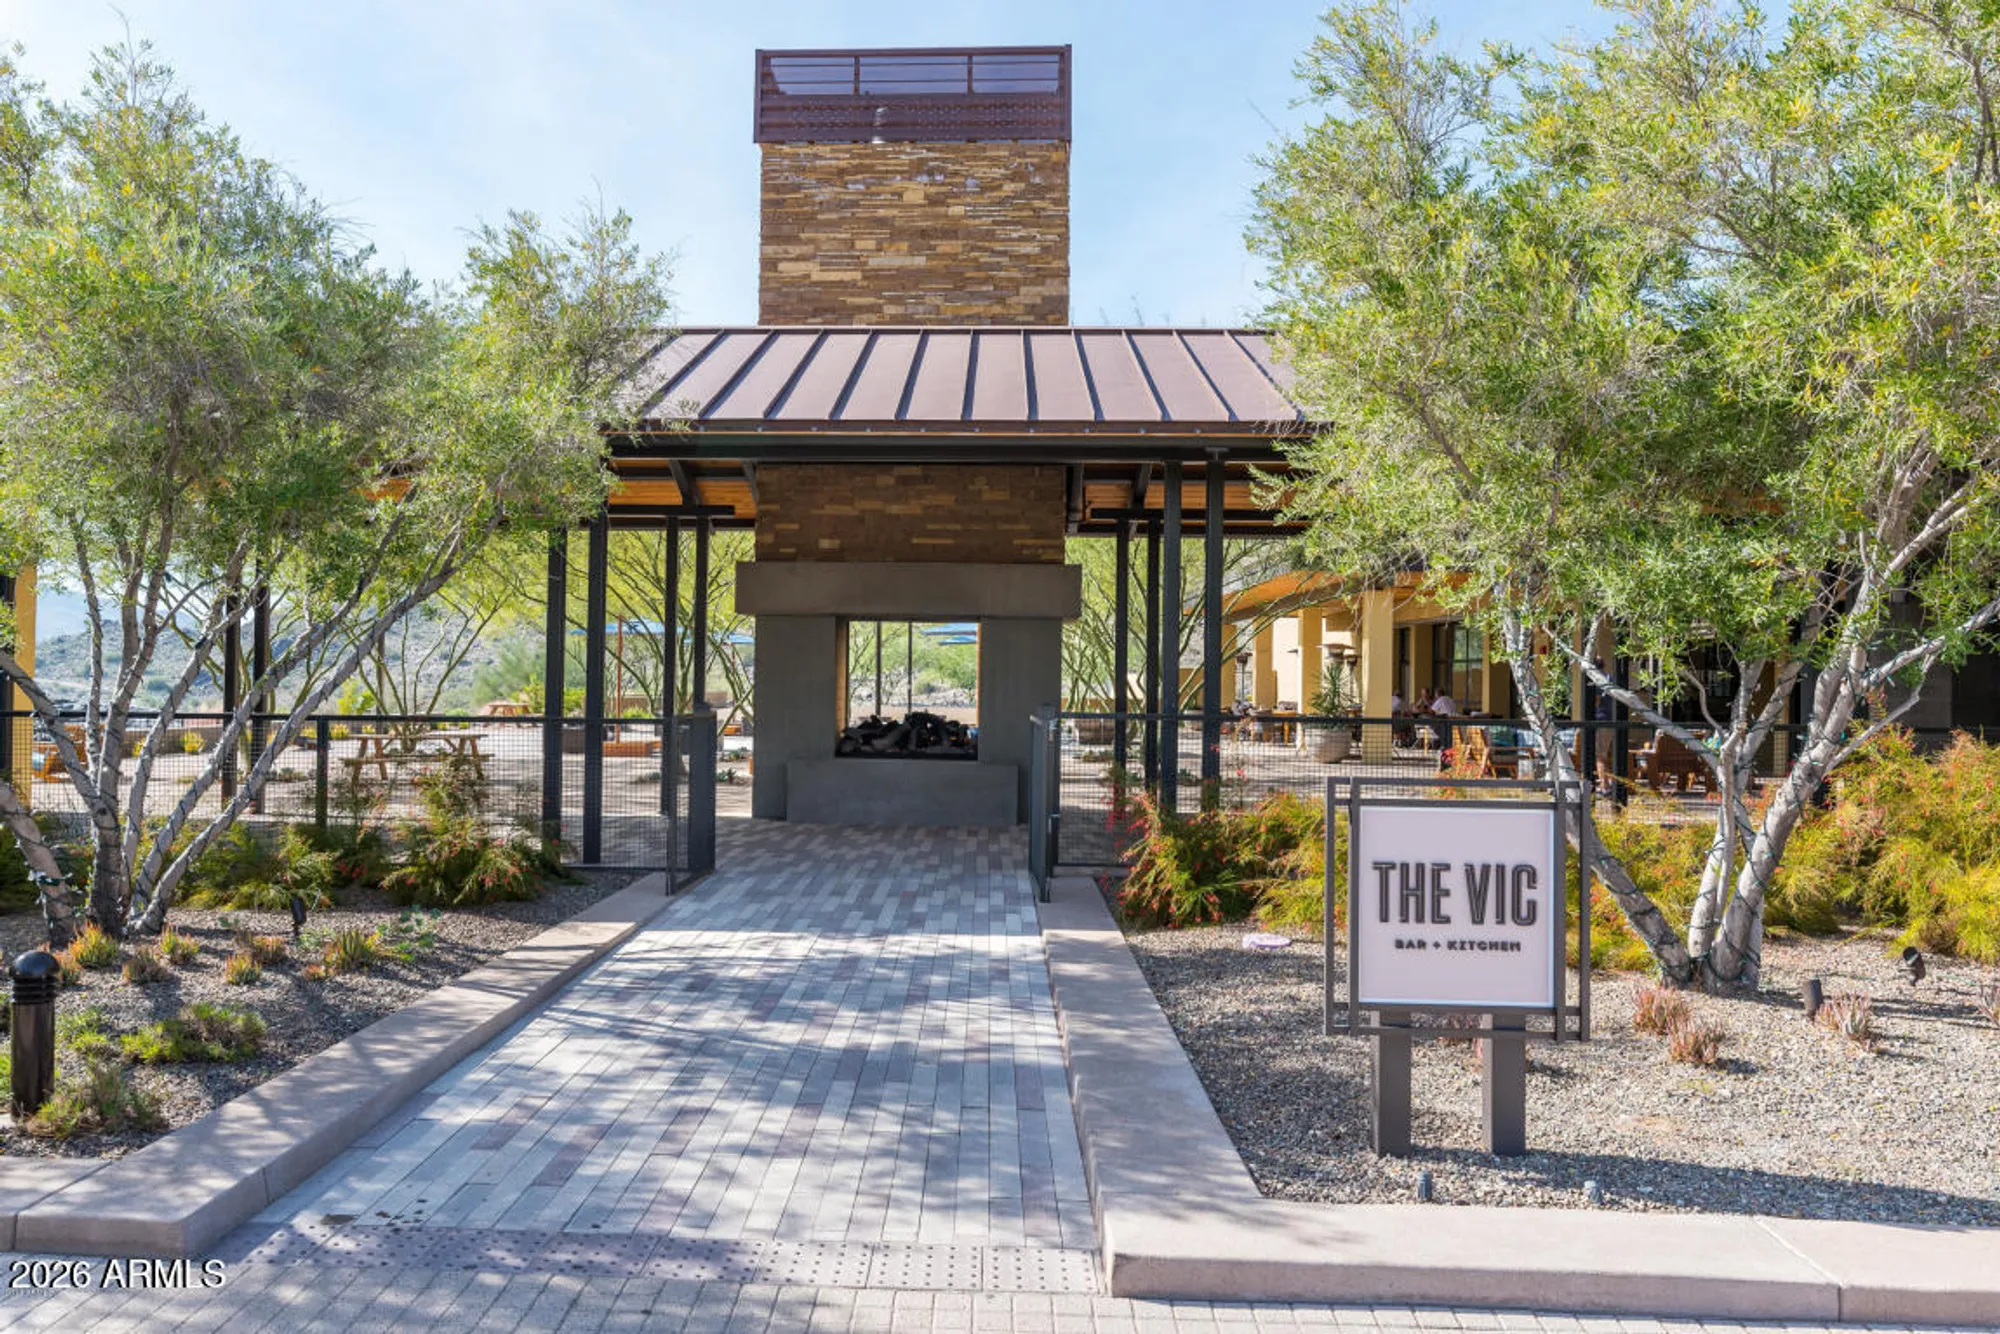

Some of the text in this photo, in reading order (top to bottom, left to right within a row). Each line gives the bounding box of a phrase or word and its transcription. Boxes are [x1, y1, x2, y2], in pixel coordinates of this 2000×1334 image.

[1372, 861, 1538, 927] THE VIC
[1395, 938, 1427, 951] BAR
[1447, 940, 1522, 953] KITCHEN
